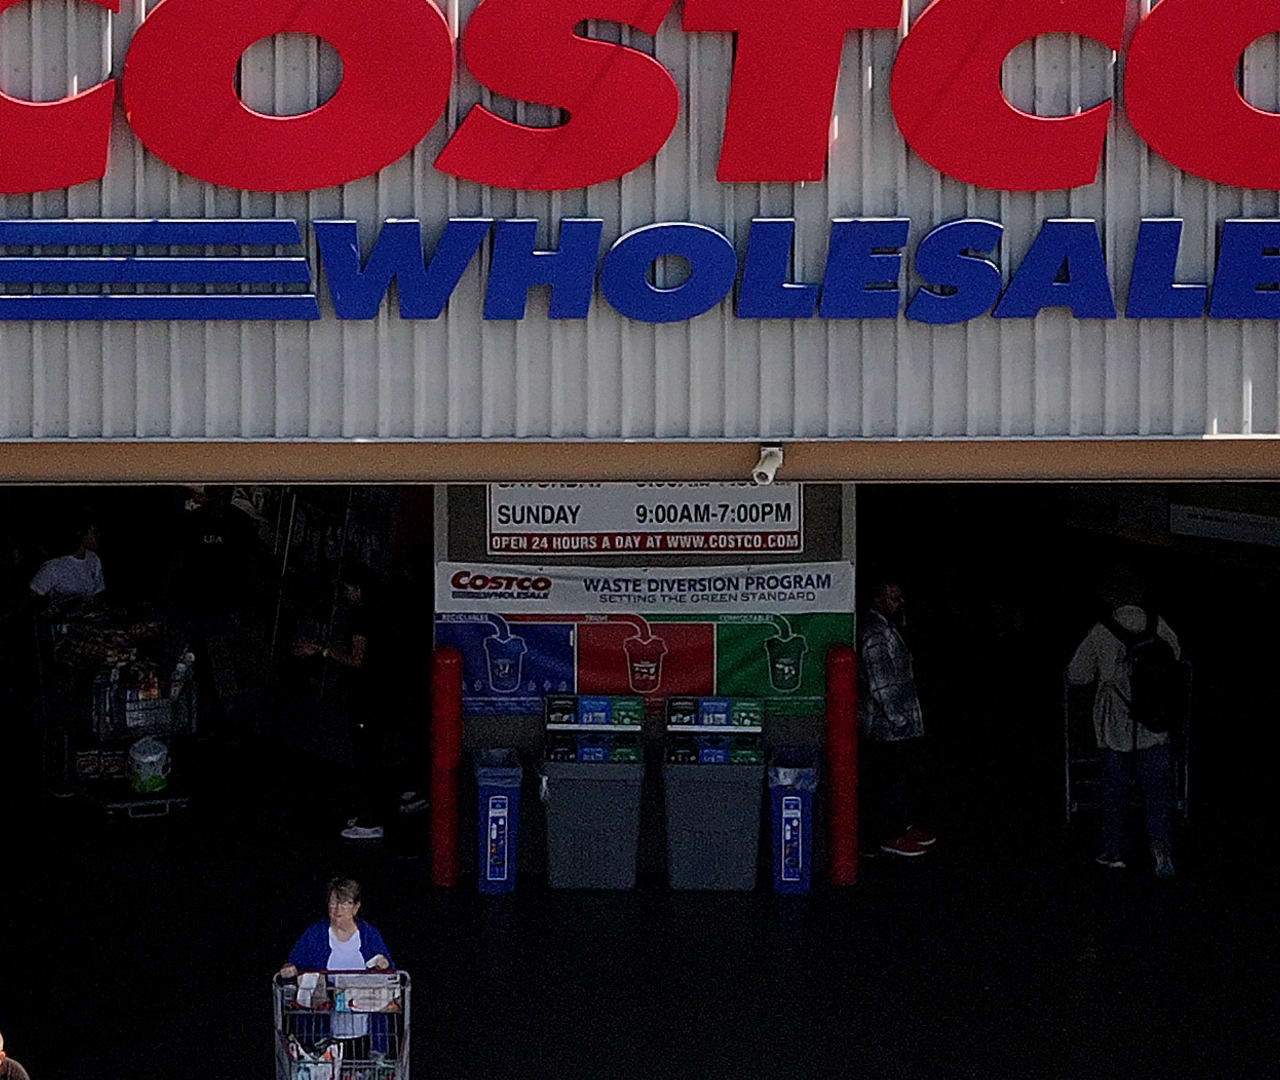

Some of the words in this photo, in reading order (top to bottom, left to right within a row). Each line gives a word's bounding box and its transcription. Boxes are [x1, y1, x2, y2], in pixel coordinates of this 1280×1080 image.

[498, 505, 580, 524] SUNDAY
[636, 503, 791, 523] 9:00AM-7:00PM
[491, 536, 527, 550] OPEN
[531, 536, 549, 550] 24
[553, 536, 597, 550] HOURS
[601, 535, 610, 549] A
[616, 535, 641, 549] DAY
[646, 535, 663, 549] AT
[666, 534, 799, 549] WWW.COSTCO.COM
[452, 572, 551, 591] COSTCO
[584, 578, 642, 593] WASTE
[648, 577, 739, 592] DIVERSION
[745, 574, 831, 590] PROGRAM
[484, 591, 549, 599] WHOLESALE
[599, 593, 657, 604] SETTING
[661, 593, 687, 603] THE
[690, 593, 738, 603] GREEN
[740, 590, 816, 602] STANDARD
